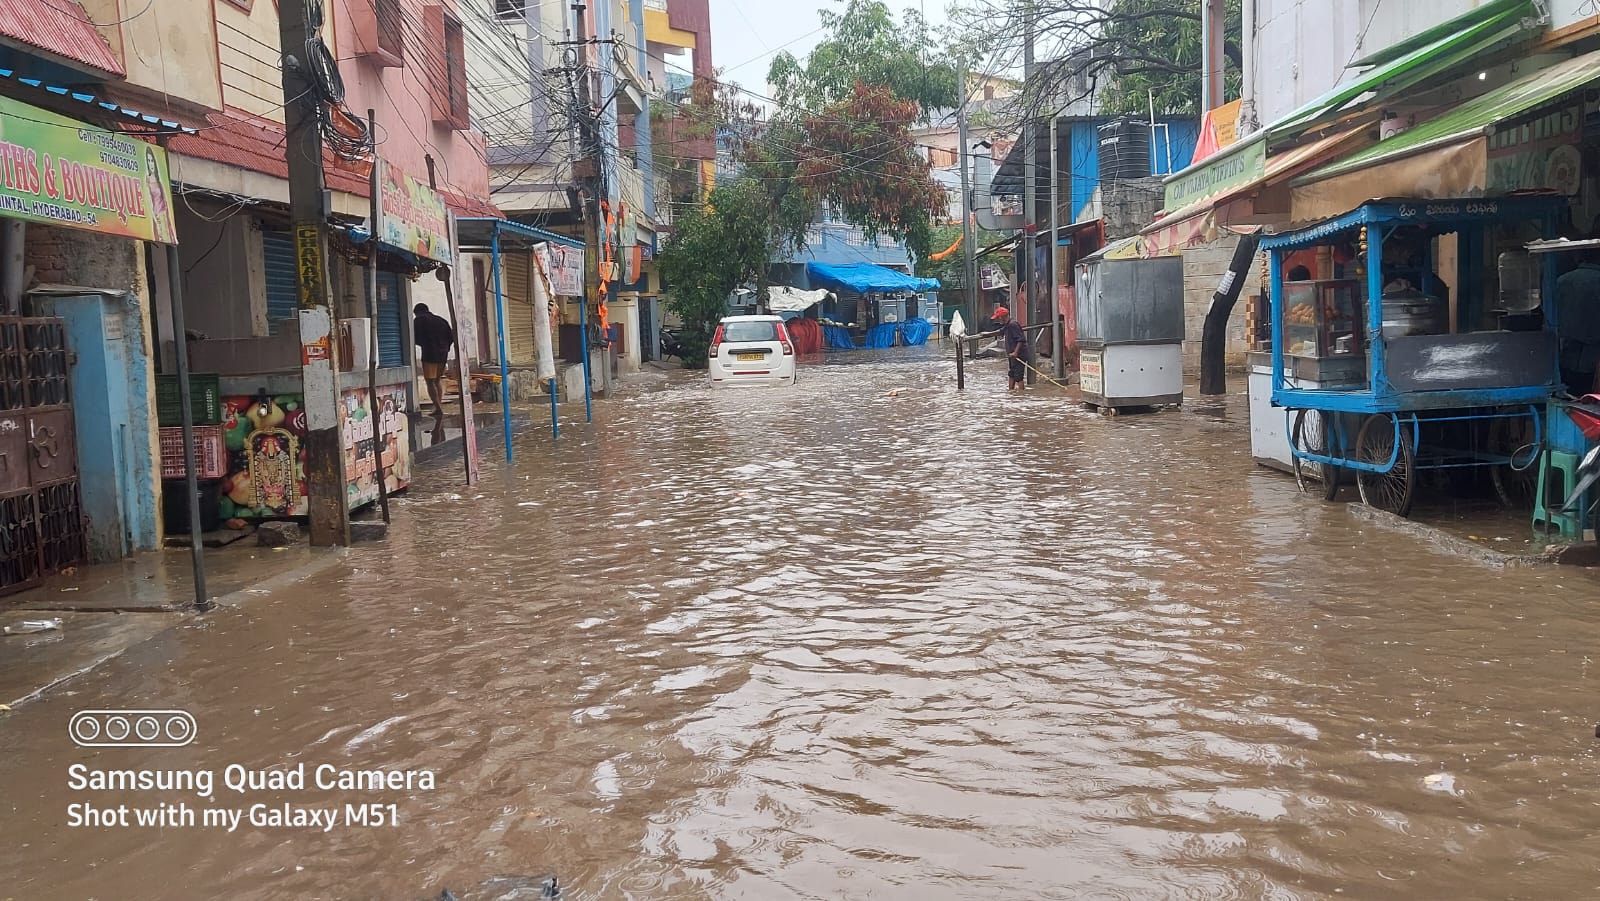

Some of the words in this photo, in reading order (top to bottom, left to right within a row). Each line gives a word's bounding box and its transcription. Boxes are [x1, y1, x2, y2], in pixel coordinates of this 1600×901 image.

[0, 140, 40, 195] THS
[43, 153, 60, 199] &
[59, 156, 147, 225] BOUTIQUE
[0, 194, 32, 216] INTAL,
[32, 201, 82, 224] HYDERABAD
